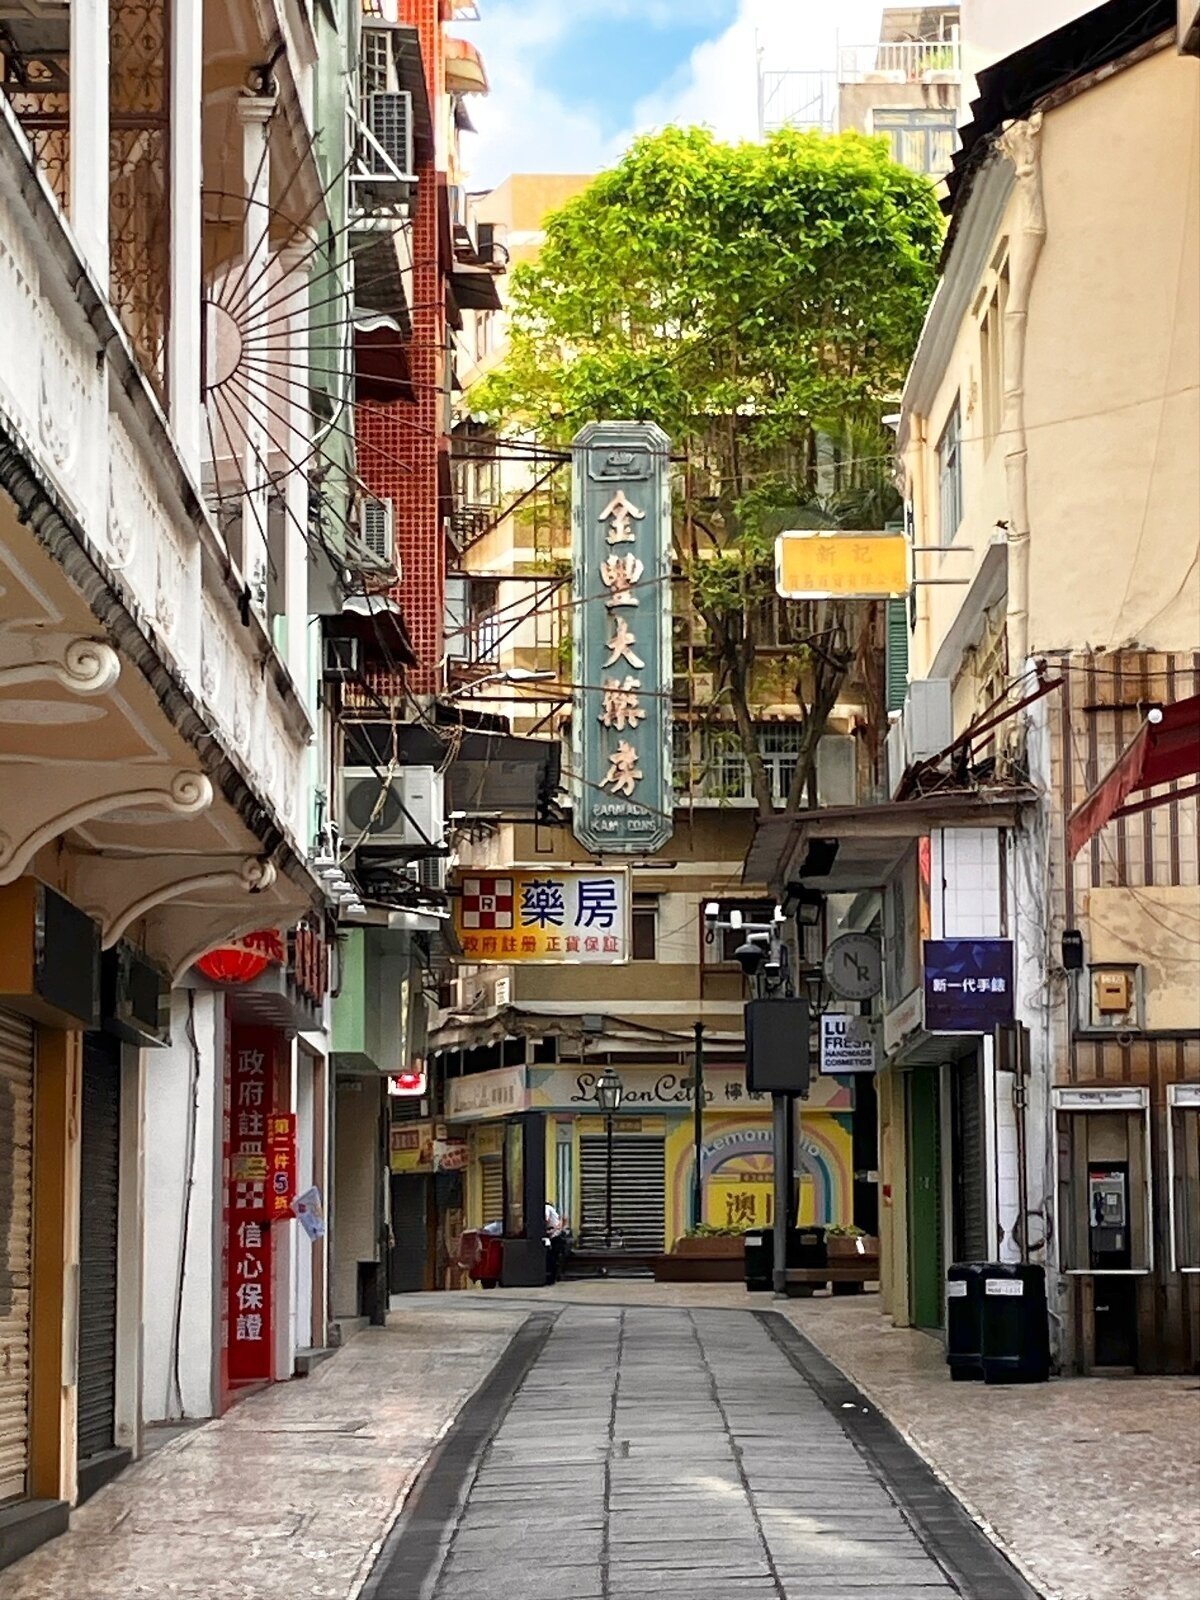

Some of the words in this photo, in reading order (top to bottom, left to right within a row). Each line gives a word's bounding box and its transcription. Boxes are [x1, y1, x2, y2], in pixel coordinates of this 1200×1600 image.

[482, 897, 493, 909] R
[520, 879, 618, 929] 藥房
[825, 1058, 872, 1066] COSMETICS
[236, 1221, 264, 1341] 信心保證
